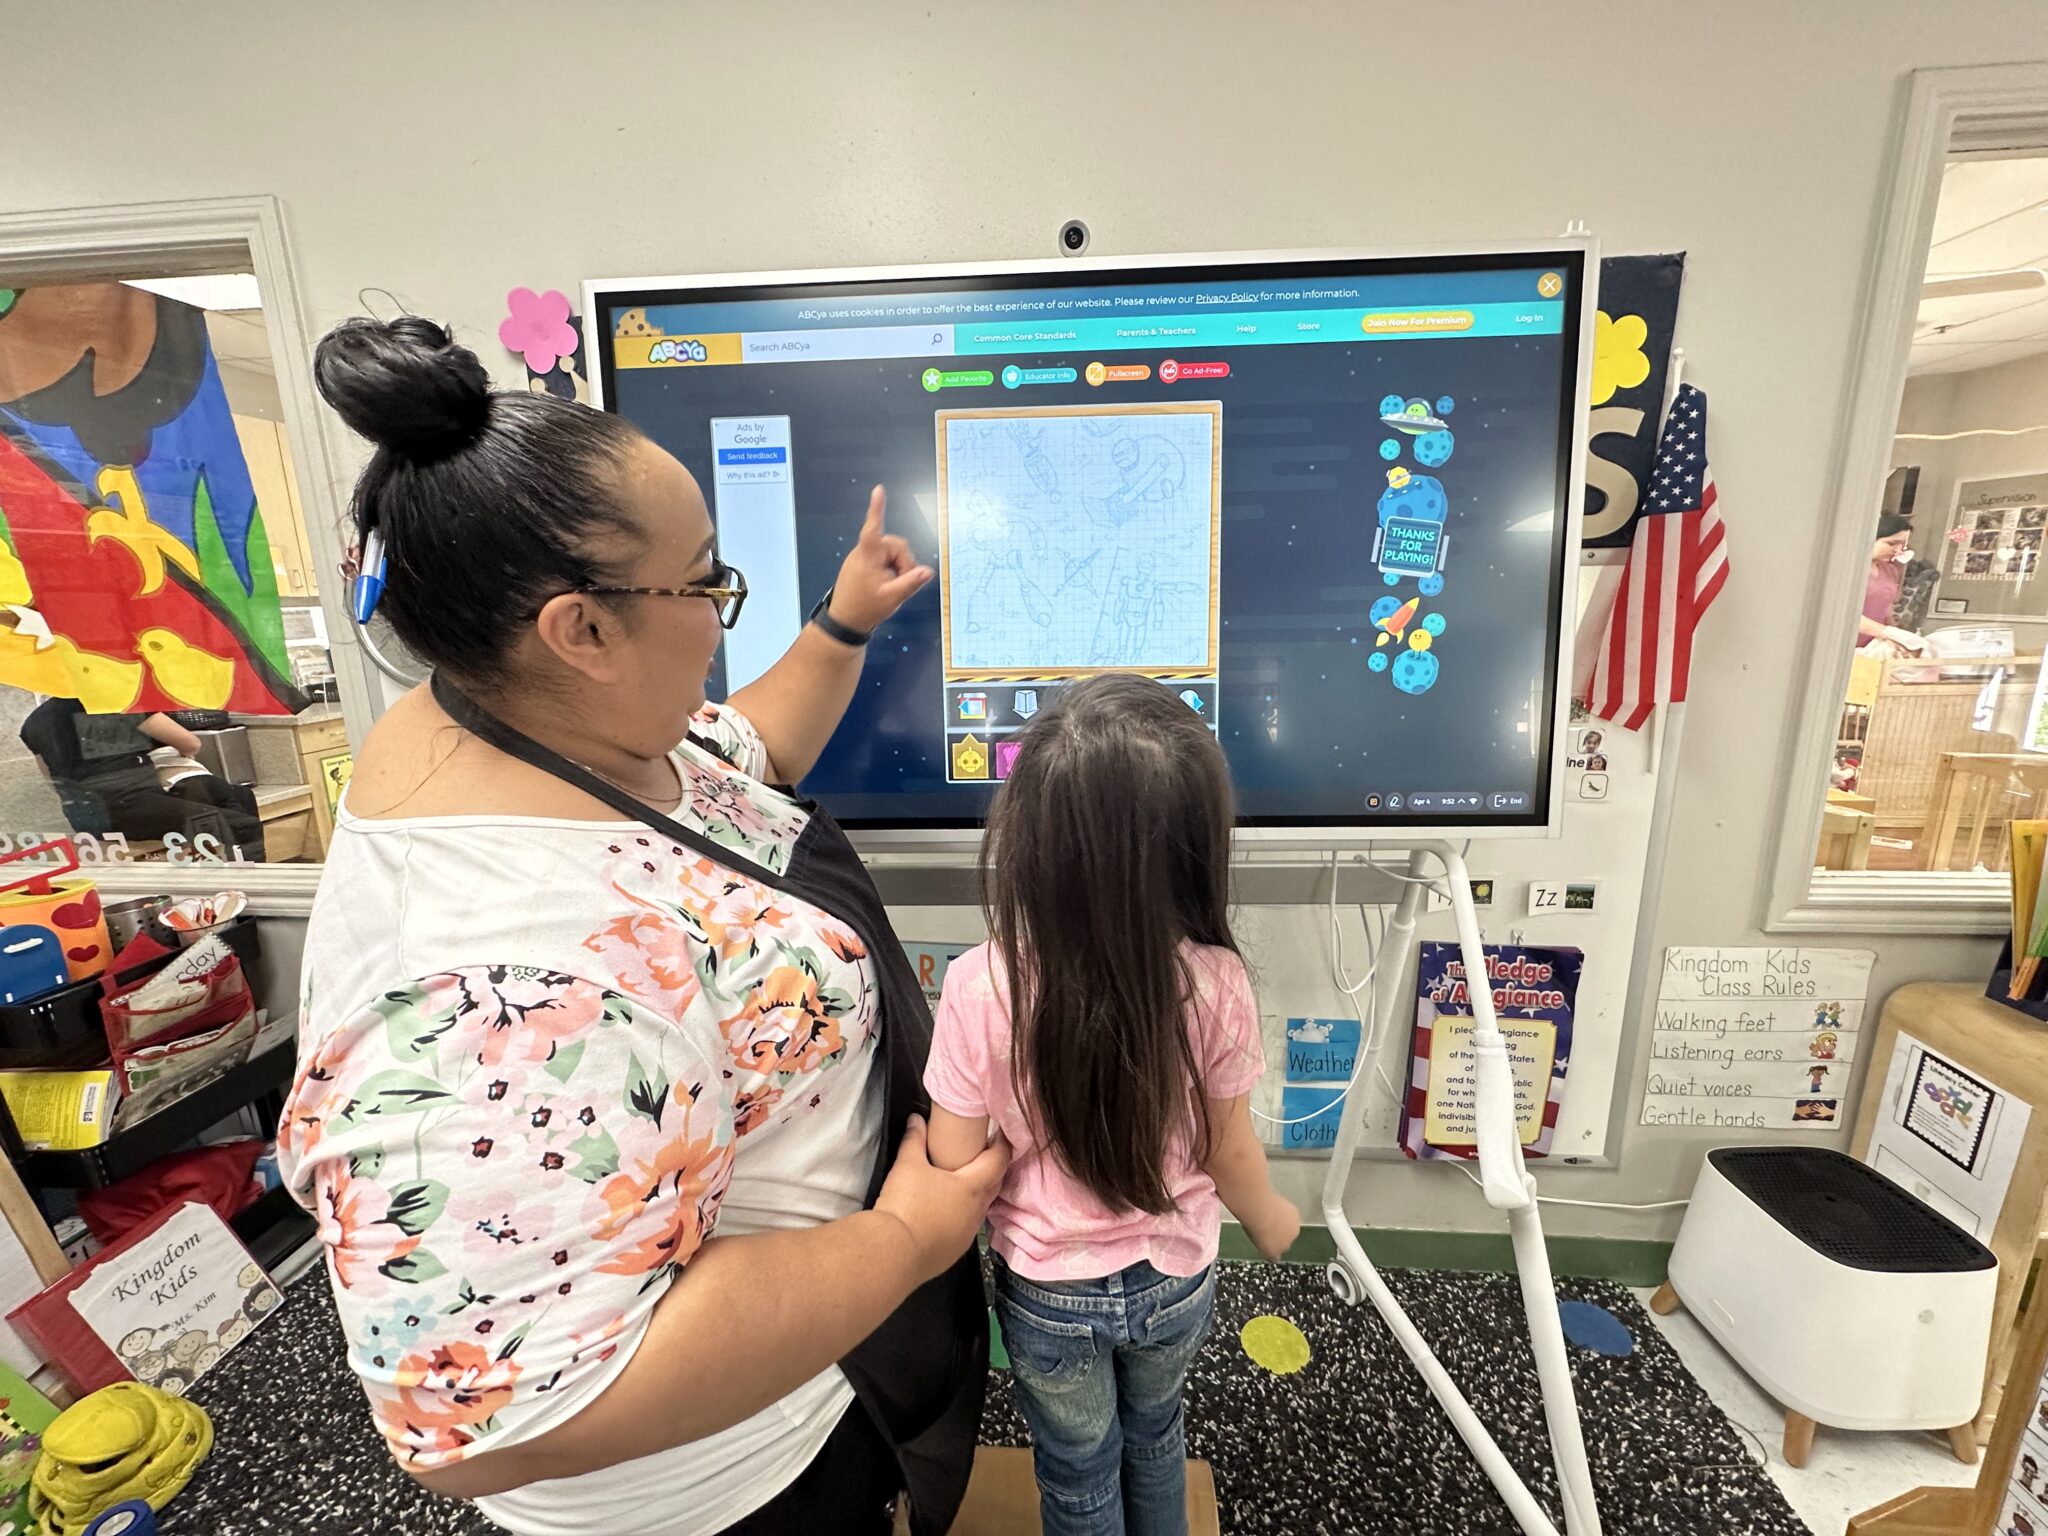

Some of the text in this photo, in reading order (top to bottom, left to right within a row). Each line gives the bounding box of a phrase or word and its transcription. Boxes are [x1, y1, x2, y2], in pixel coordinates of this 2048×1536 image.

[798, 288, 1360, 321] ABCya uses cookies in order to offer the best experience of our website. Please review our Privacy Policy for more information.
[1367, 316, 1468, 329] Join Now For Premium
[1515, 313, 1544, 325] Log In
[1116, 326, 1197, 338] Parents & Teachers
[1236, 324, 1257, 335] Help
[1296, 322, 1320, 332] Store
[974, 331, 1077, 343] Common Core Standards
[749, 341, 811, 353] Search ABCya
[1025, 371, 1071, 382] Educator Info
[1108, 369, 1145, 378] Fullscreen
[1182, 367, 1193, 375] Go
[944, 374, 987, 384] Add Favorite
[736, 422, 765, 433] Ads by
[734, 433, 767, 445] Google
[727, 451, 778, 461] Send feedback
[726, 469, 771, 480] Why this ad?
[1391, 527, 1435, 542] THANKS
[1400, 539, 1422, 552] FOR
[1384, 550, 1434, 565] PLAYING!
[1413, 798, 1425, 806] Apr
[1510, 796, 1522, 805] End
[1535, 888, 1558, 908] Zz
[1665, 948, 1811, 983] Kingdom Kids
[1702, 974, 1816, 997] Class Rules
[1431, 981, 1565, 1012] of Agiance
[1656, 1011, 1776, 1039] Walking feet
[1498, 1028, 1539, 1038] legiance
[1449, 1050, 1535, 1063] of the States
[1653, 1040, 1783, 1070] Listening ears
[1289, 1051, 1355, 1073] Weather
[1464, 1064, 1474, 1072] of
[1446, 1076, 1464, 1085] and
[1466, 1077, 1476, 1085] to
[1647, 1073, 1752, 1097] Quiet voices
[1447, 1088, 1459, 1096] for
[1456, 1100, 1475, 1109] Nati
[1438, 1112, 1476, 1121] indivisibl
[1643, 1105, 1765, 1128] Gentle hands
[1291, 1121, 1338, 1142] Cloth
[112, 1233, 201, 1302] Kingdom
[150, 1264, 198, 1306] Kids
[172, 1291, 217, 1331] Ms. Kim
